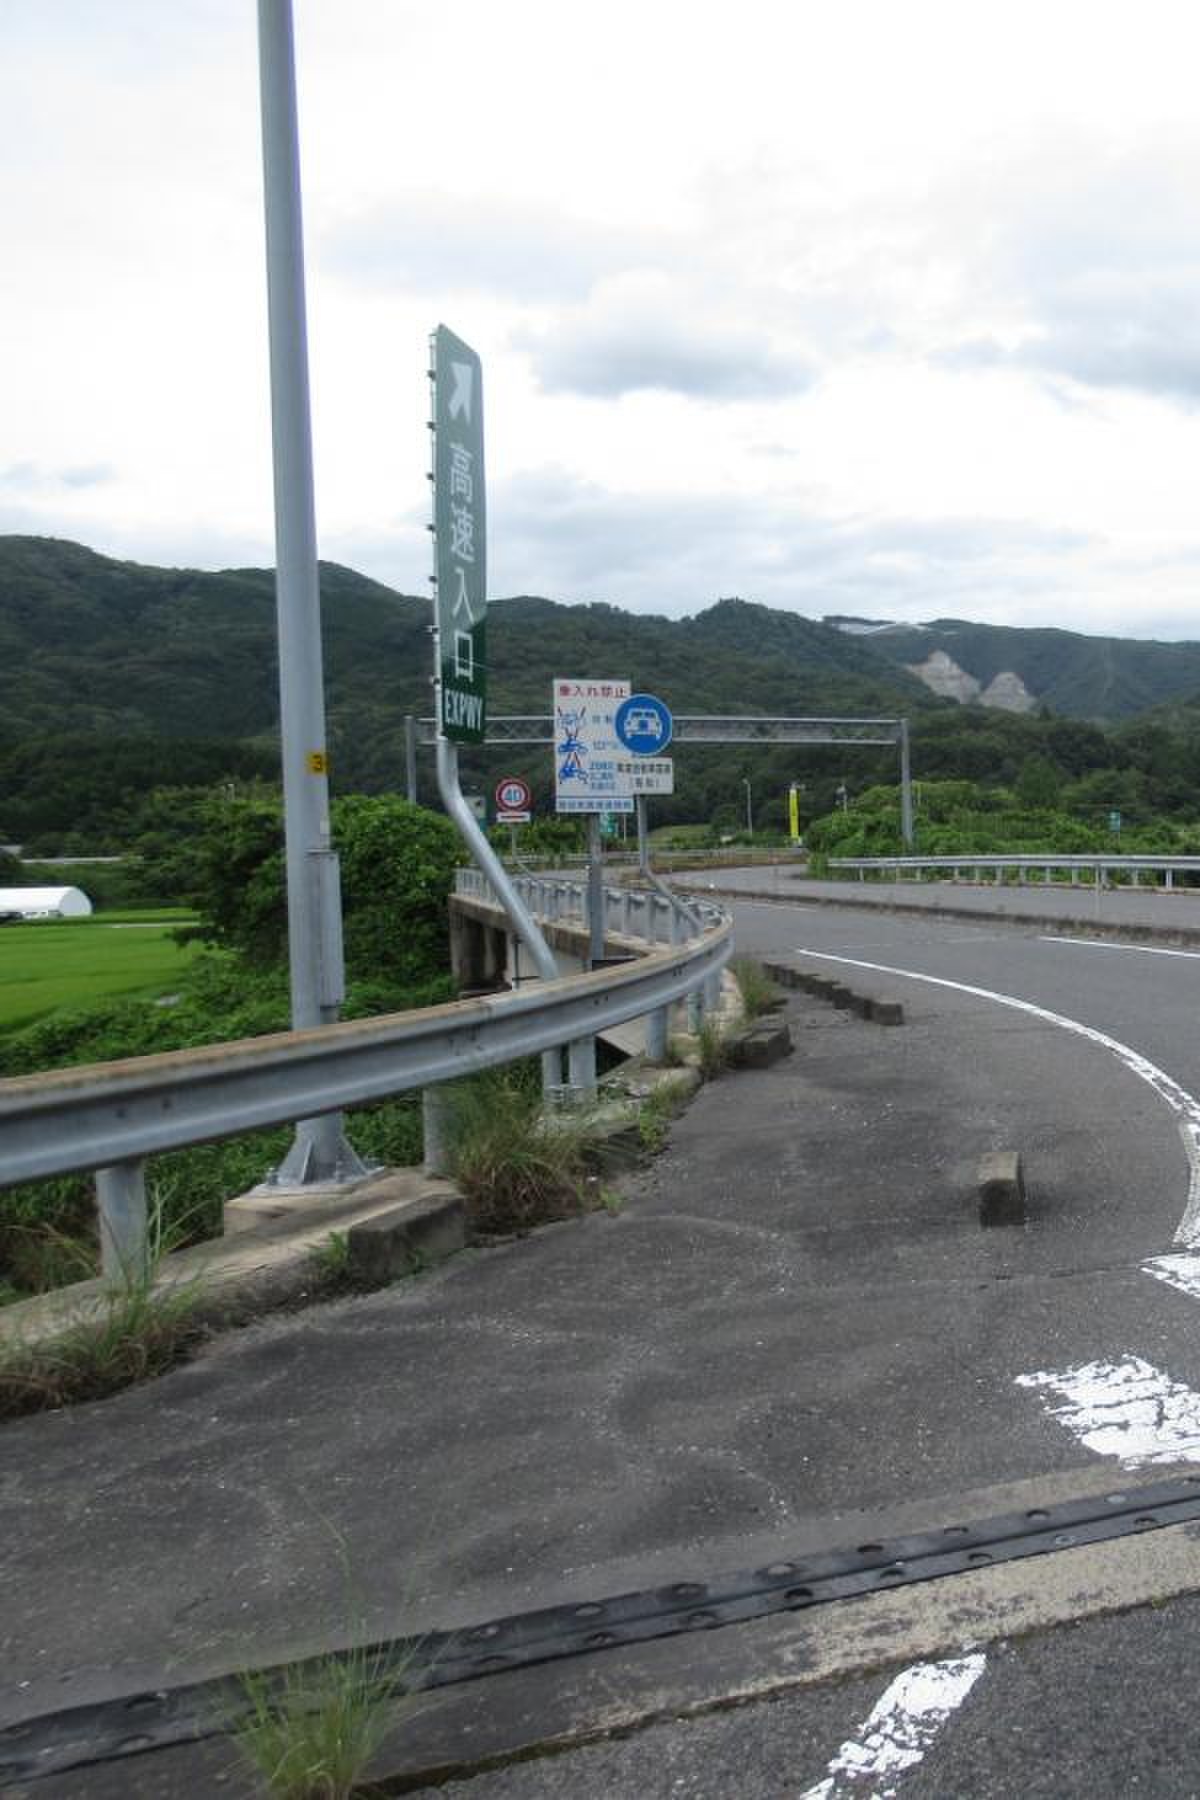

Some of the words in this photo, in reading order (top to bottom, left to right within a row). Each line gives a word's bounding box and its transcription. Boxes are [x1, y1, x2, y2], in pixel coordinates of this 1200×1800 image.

[449, 442, 475, 683] 高速入口
[445, 690, 482, 730] EXPWY
[504, 788, 523, 802] 40
